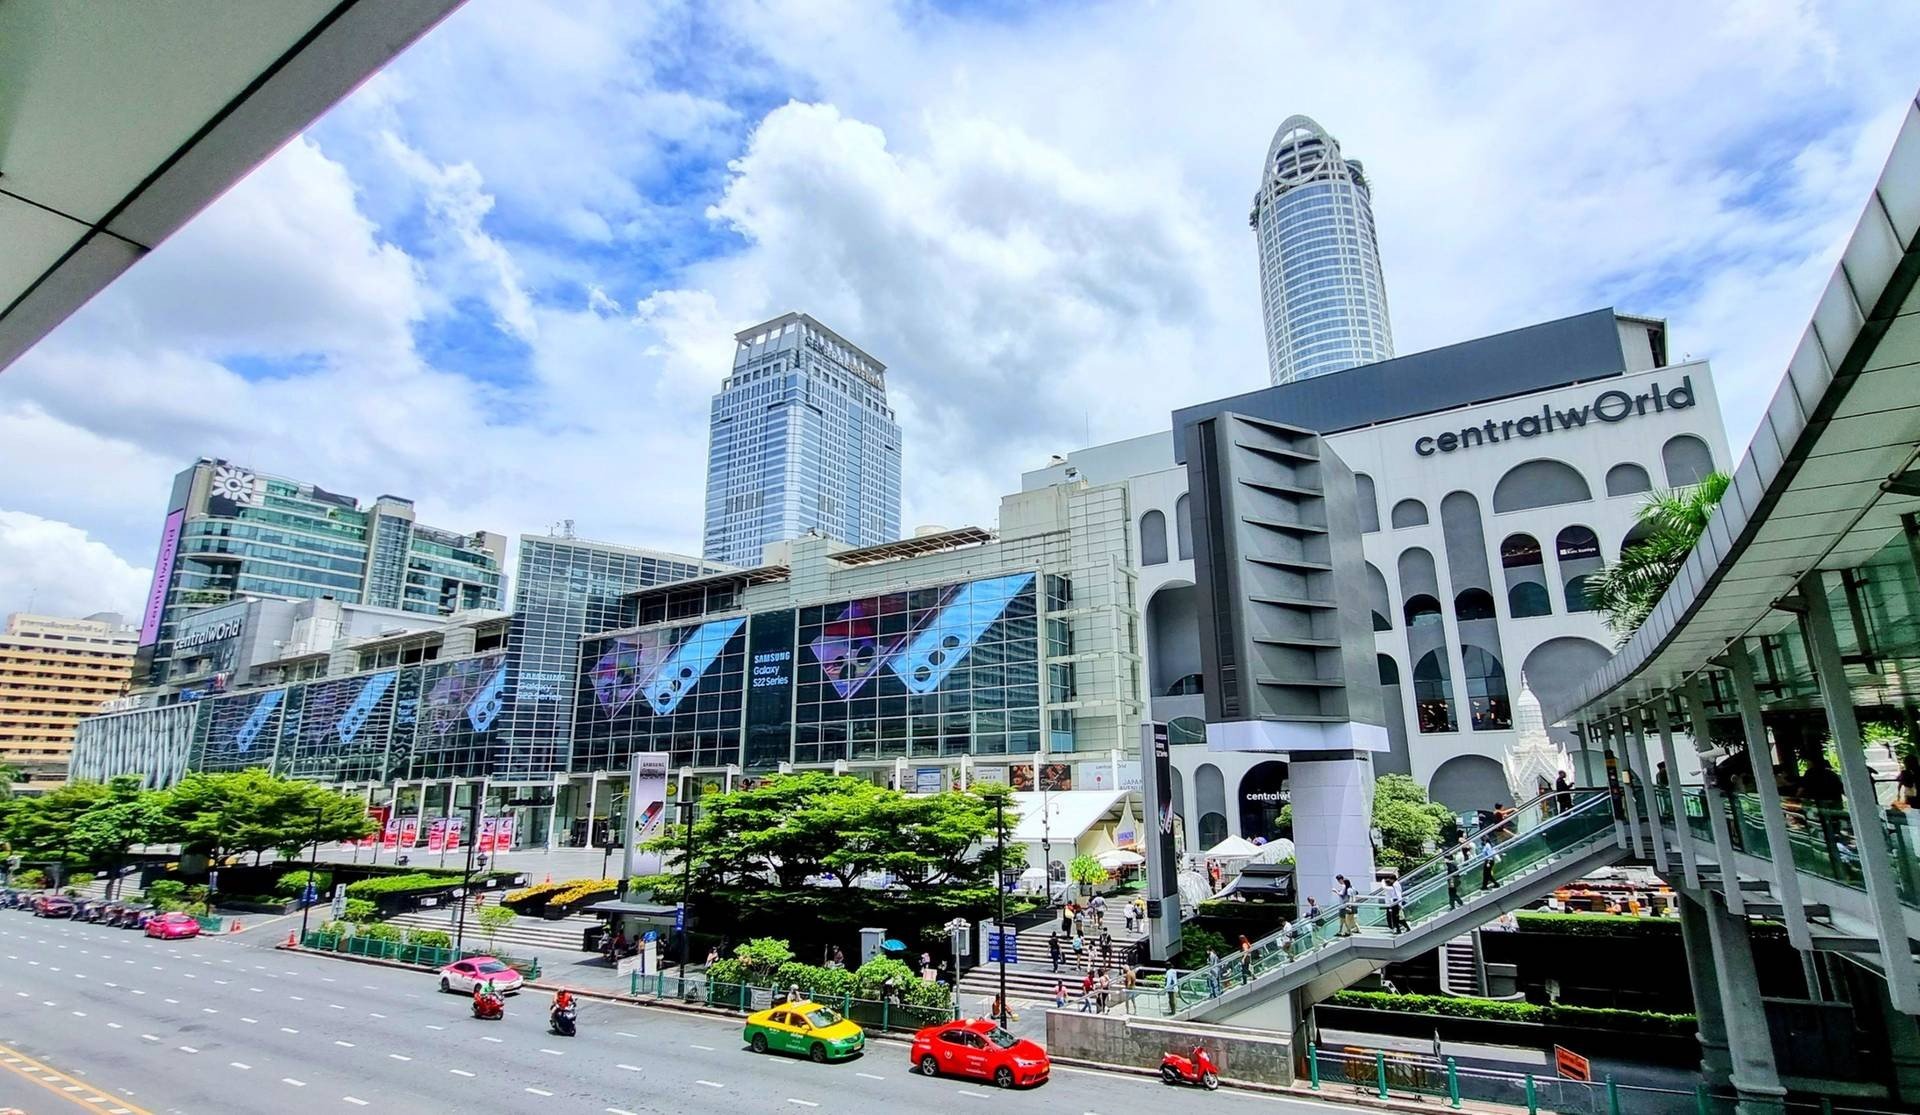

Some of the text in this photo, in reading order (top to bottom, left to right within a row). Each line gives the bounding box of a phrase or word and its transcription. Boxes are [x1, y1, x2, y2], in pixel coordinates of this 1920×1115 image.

[1414, 375, 1697, 457] centralwOrld
[173, 618, 242, 650] centralwOrld
[754, 651, 791, 664] SAMSUNG
[753, 665, 780, 676] Galaxy
[752, 675, 789, 687] S22 Series
